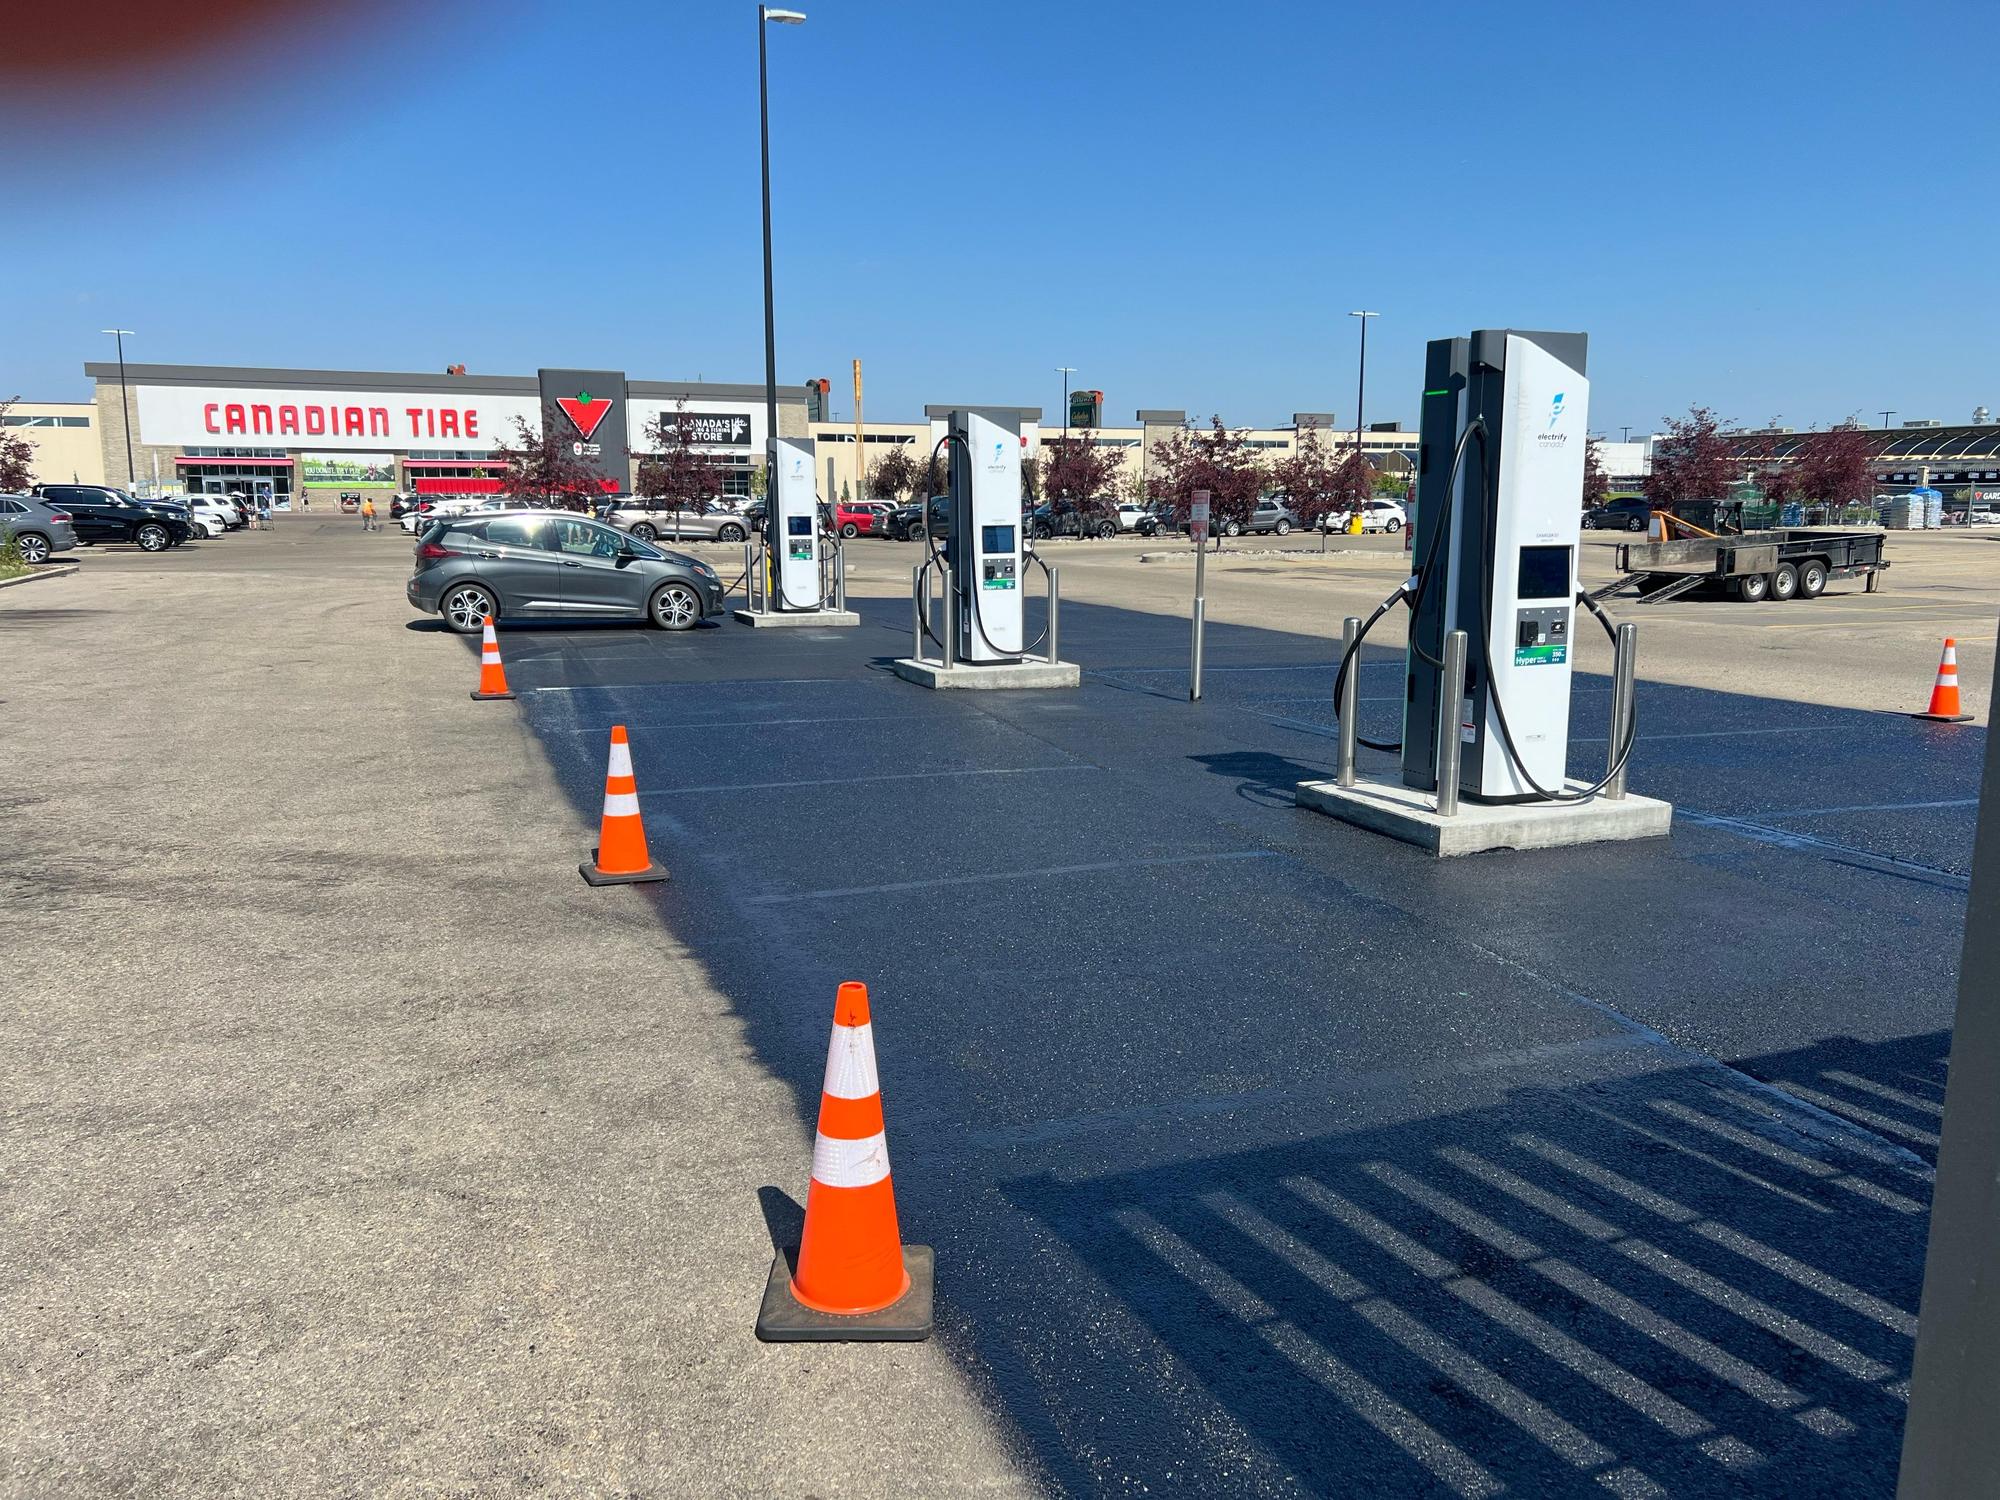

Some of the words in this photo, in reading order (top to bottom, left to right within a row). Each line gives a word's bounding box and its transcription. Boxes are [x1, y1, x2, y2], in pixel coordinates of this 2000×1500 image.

[204, 403, 389, 437] CANADIAN
[406, 408, 479, 438] TIRE
[682, 419, 731, 429] ANADA'S
[691, 431, 723, 441] STORE
[1537, 433, 1568, 442] electrify
[1515, 656, 1537, 666] Hyper
